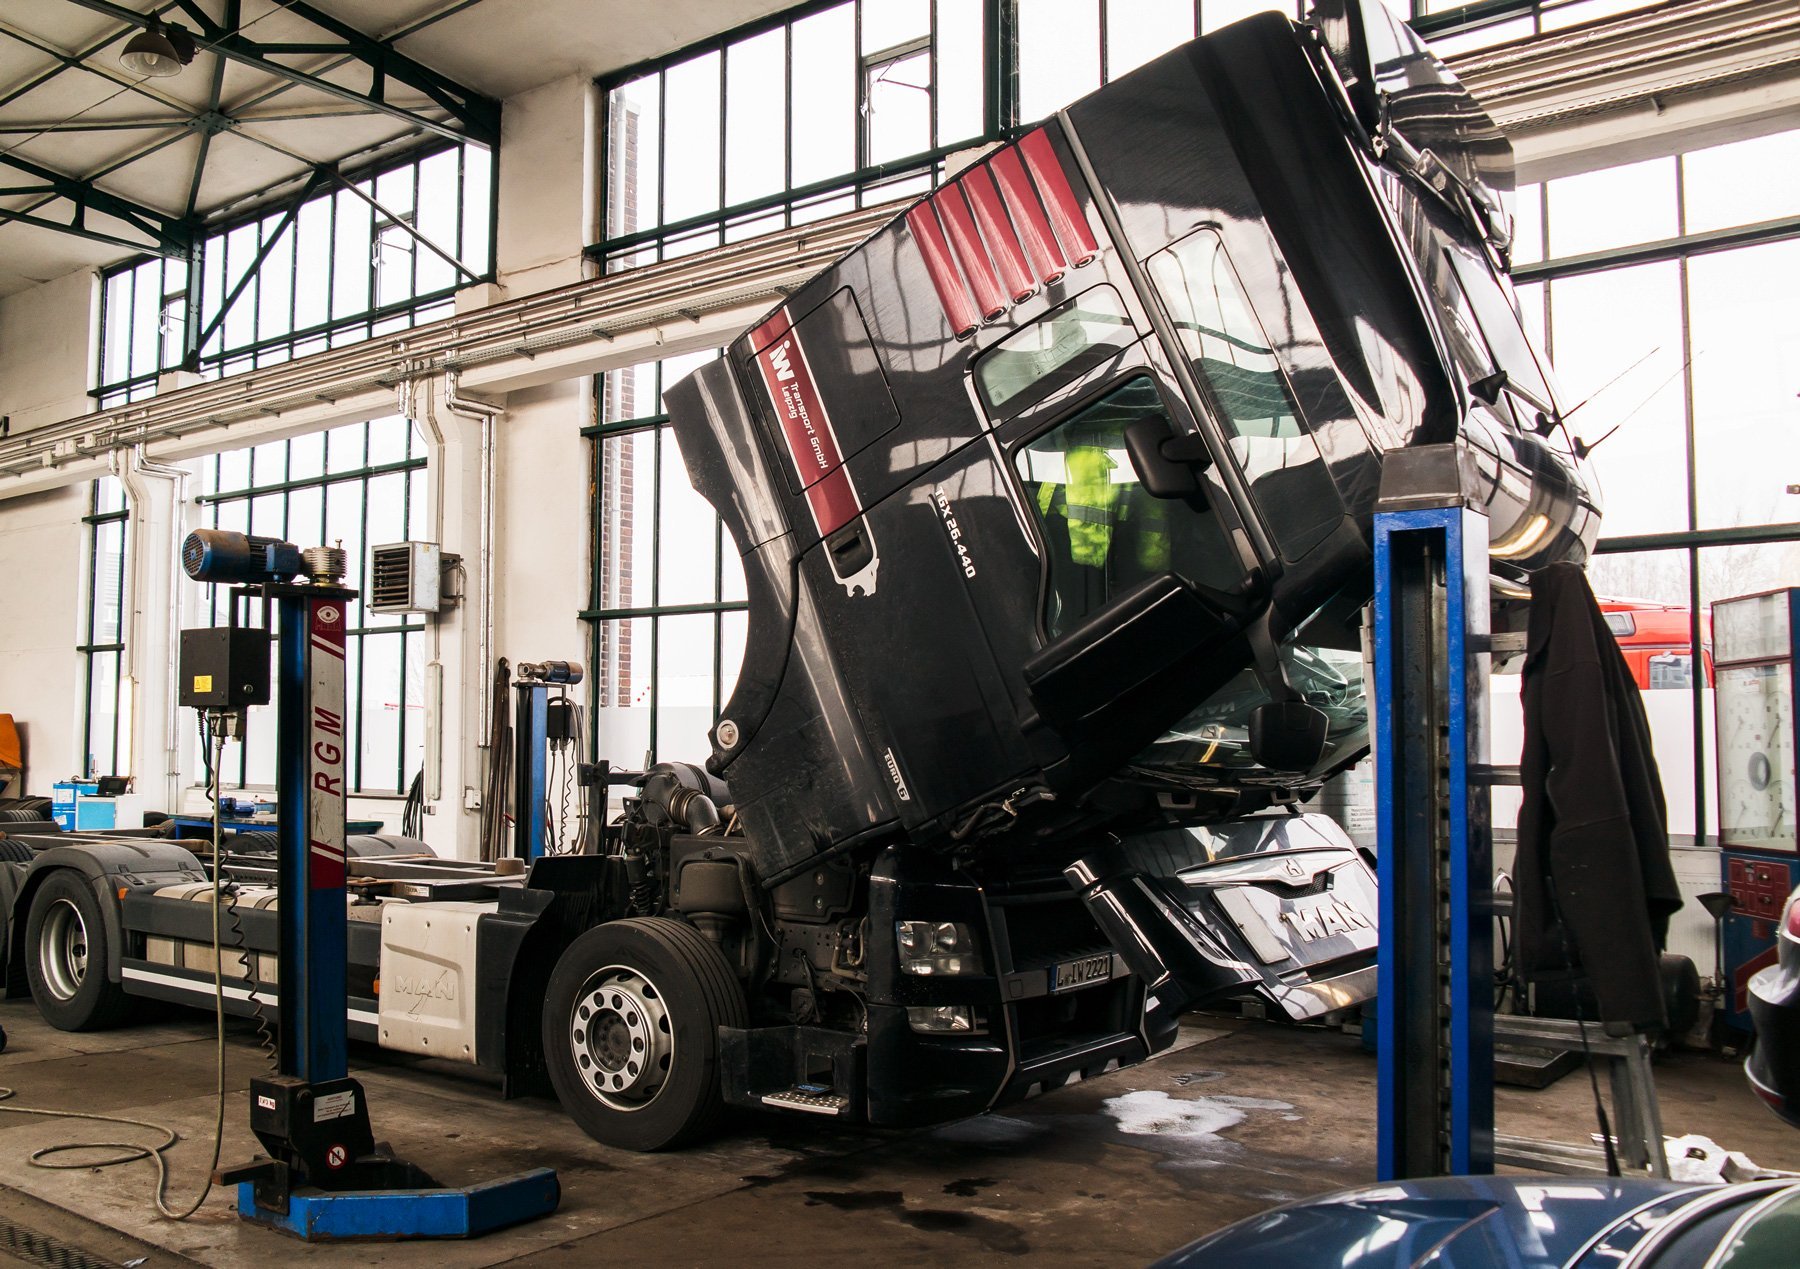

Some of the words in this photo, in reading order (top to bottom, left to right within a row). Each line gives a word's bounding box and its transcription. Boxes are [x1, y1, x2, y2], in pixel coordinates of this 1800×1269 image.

[781, 386, 798, 419] Leipzig
[790, 382, 815, 435] Transport
[810, 436, 829, 469] GmbH
[935, 486, 953, 519] TGX
[946, 517, 976, 579] 26.440
[314, 706, 341, 797] RGM
[884, 753, 900, 784] EURO
[1285, 901, 1370, 944] MAN
[394, 975, 455, 1001] MAN
